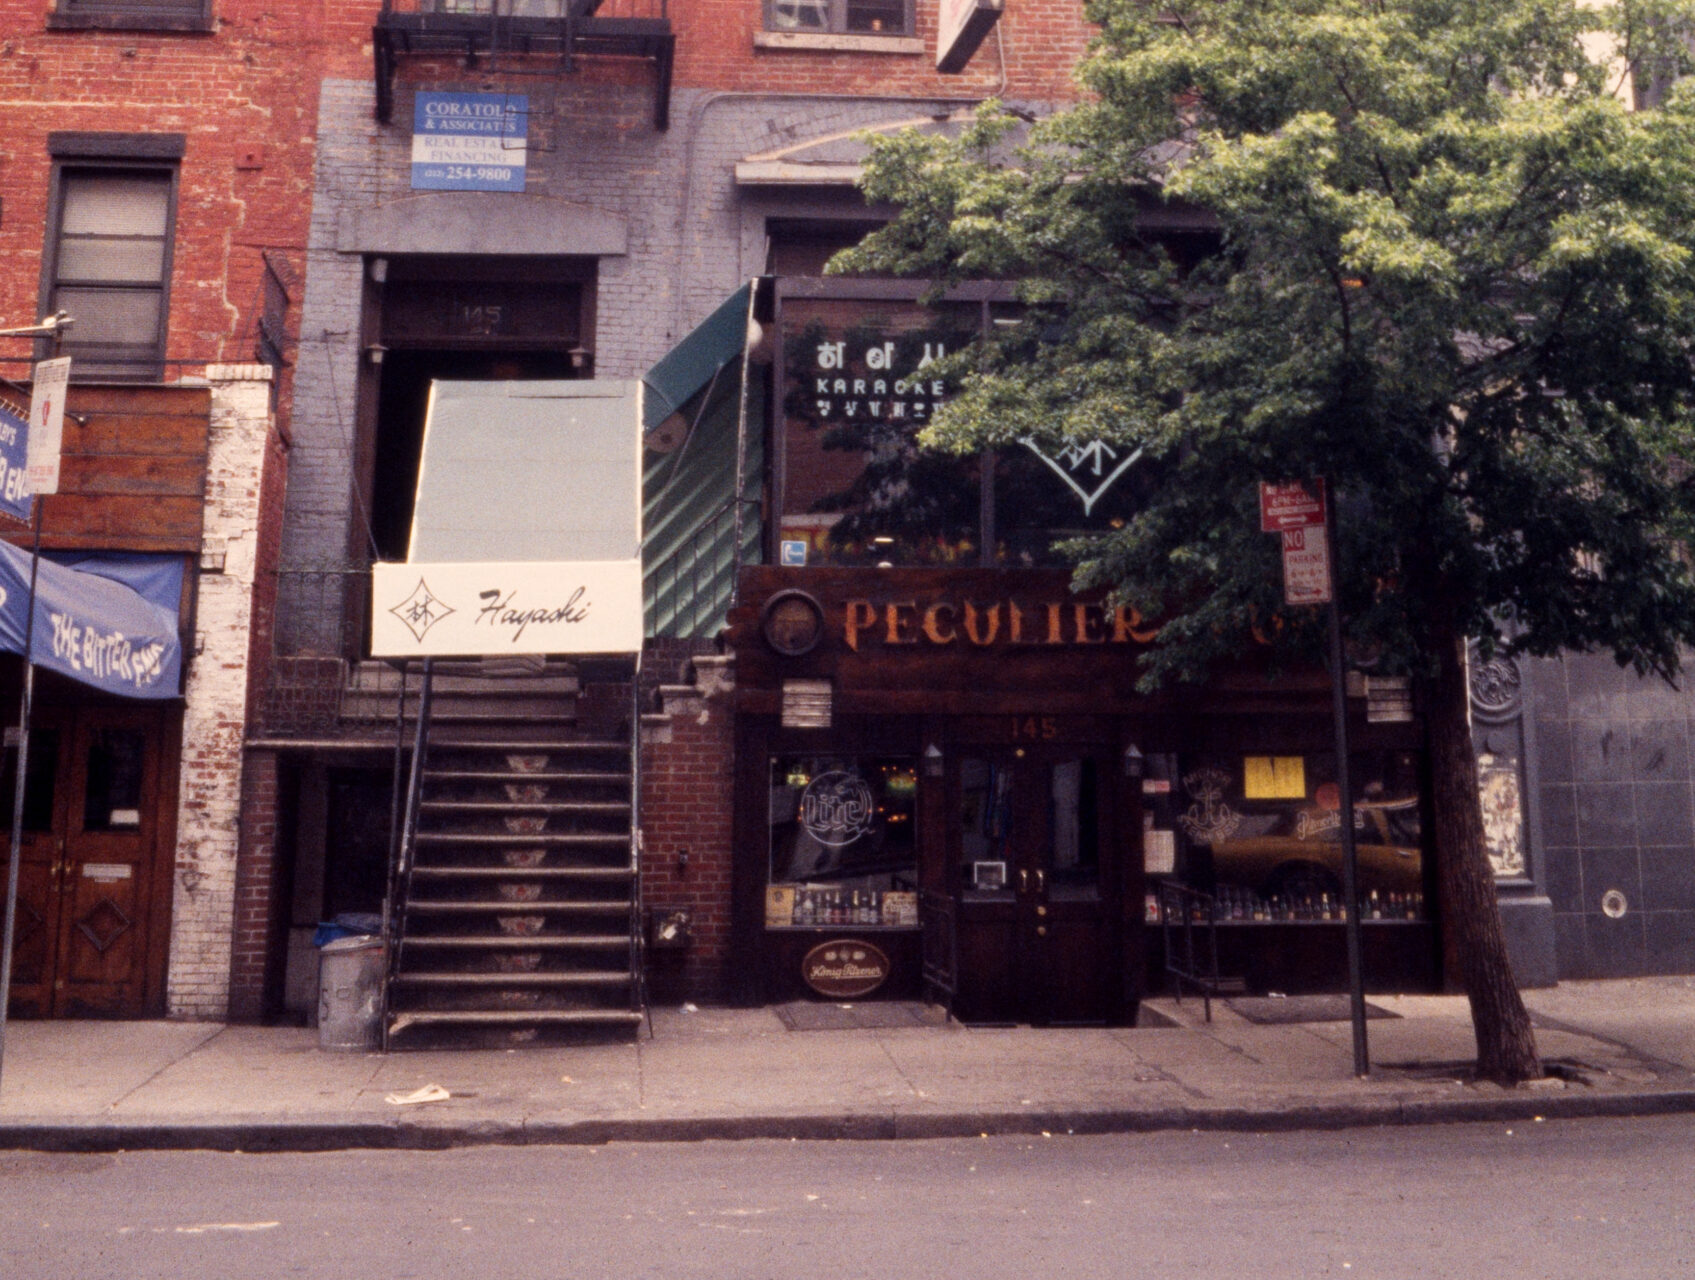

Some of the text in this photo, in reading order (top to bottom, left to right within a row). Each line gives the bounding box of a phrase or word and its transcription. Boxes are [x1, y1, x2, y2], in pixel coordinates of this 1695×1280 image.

[425, 102, 517, 117] CORATOLO
[425, 118, 435, 129] &
[424, 136, 458, 147] REAL
[446, 166, 512, 181] 254-9800
[817, 379, 944, 395] KARAOKE
[1285, 529, 1304, 549] NO
[406, 594, 434, 627] 林
[475, 586, 592, 643] Hayashi
[844, 597, 1159, 652] PECULIER
[51, 613, 82, 670] THE
[83, 626, 133, 680] BITTER
[1011, 717, 1057, 739] 145
